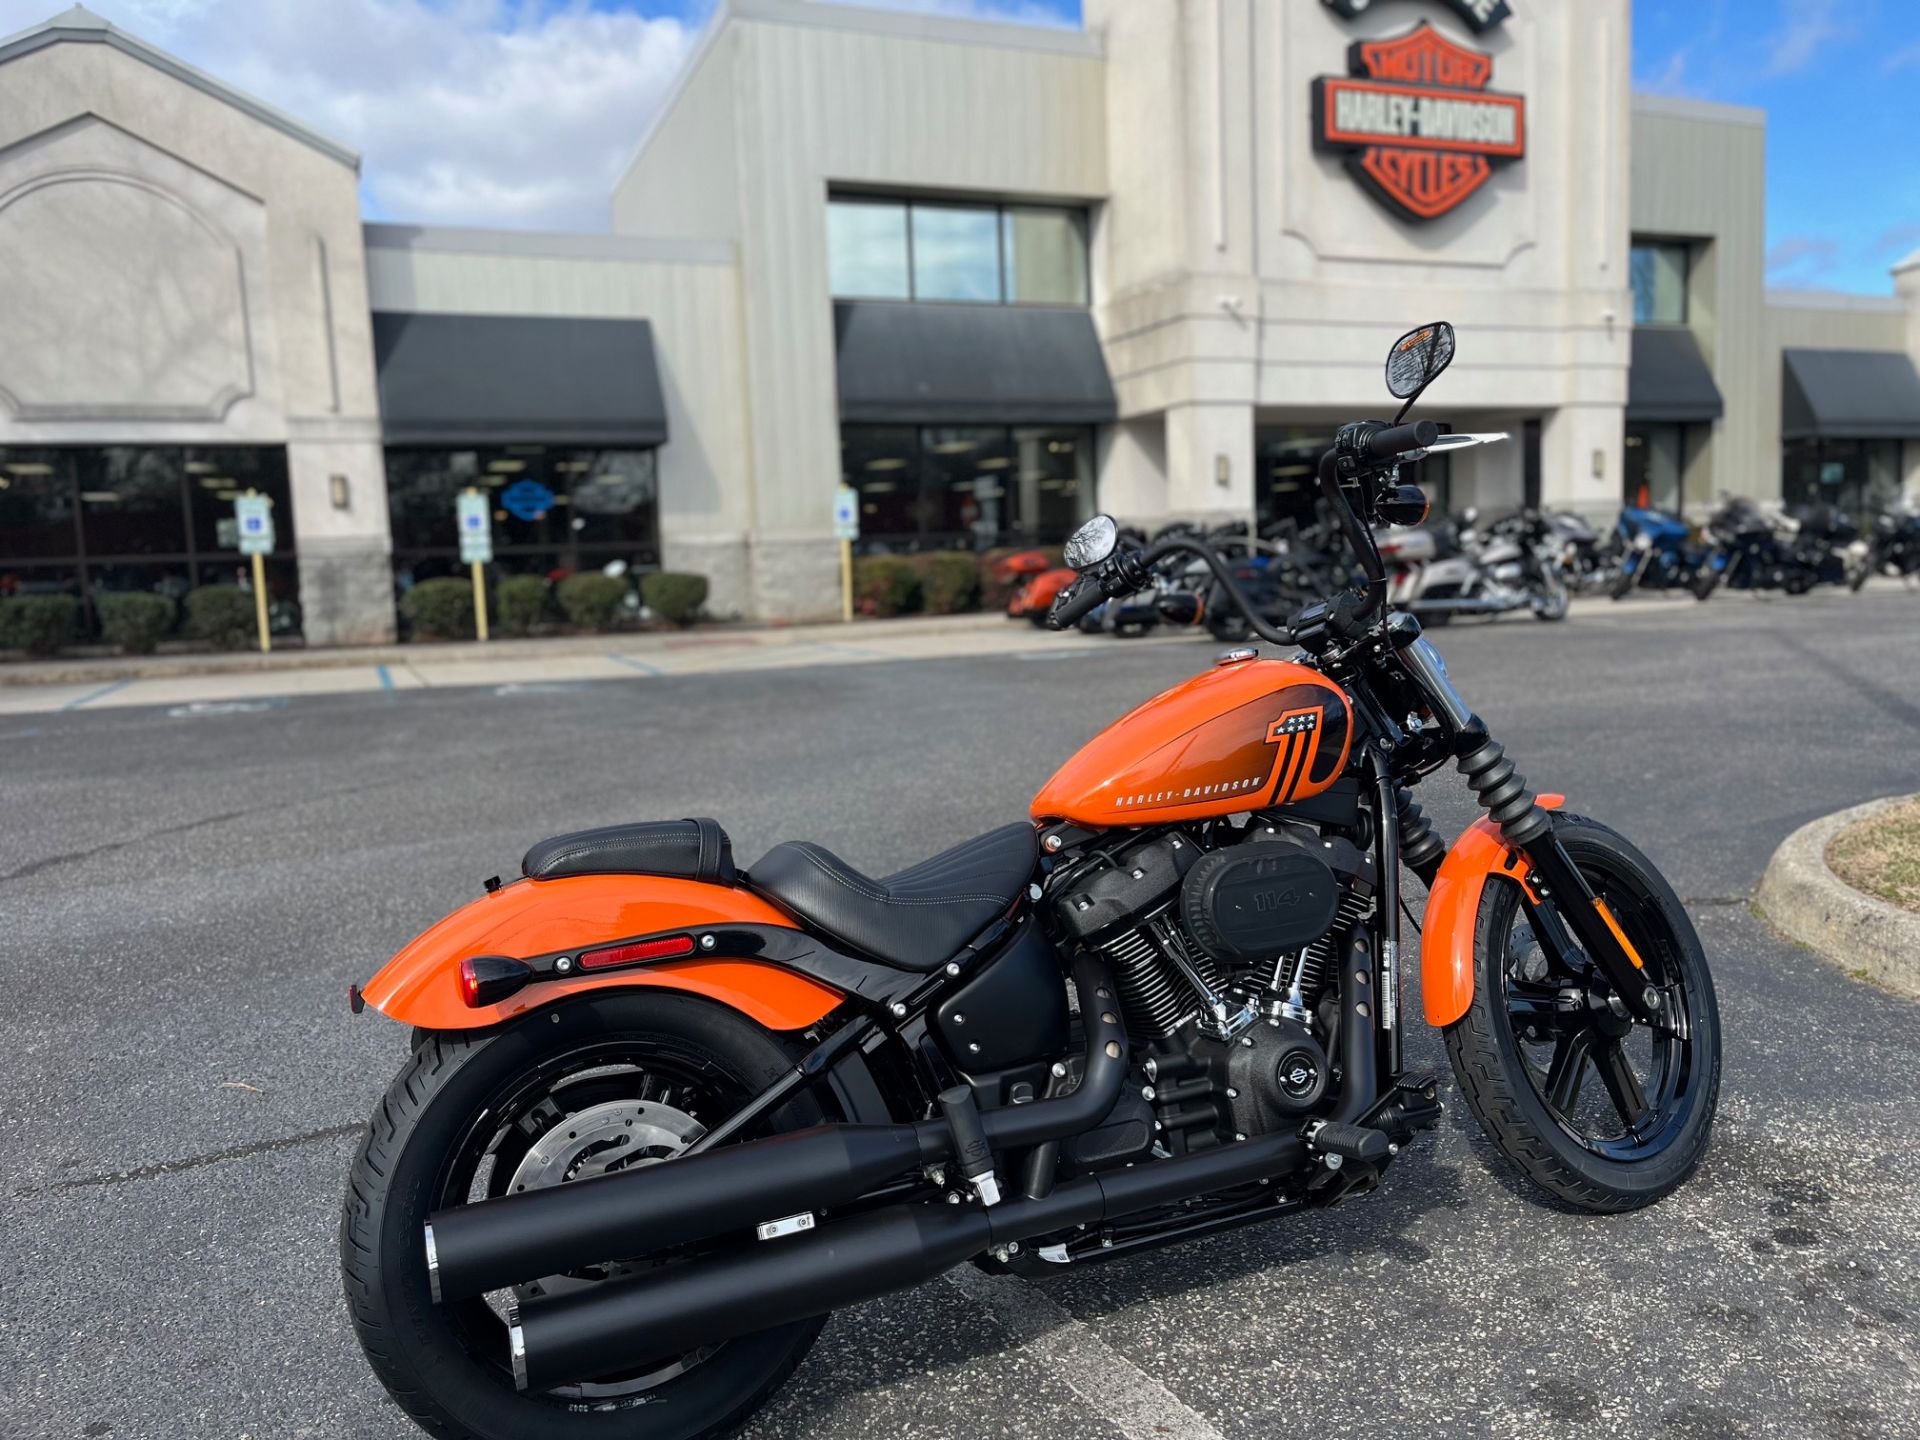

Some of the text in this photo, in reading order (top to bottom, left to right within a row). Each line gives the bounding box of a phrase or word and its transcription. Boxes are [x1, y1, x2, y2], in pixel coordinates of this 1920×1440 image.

[1336, 89, 1516, 145] HARLEY-DAVIDSON
[1116, 776, 1261, 806] HARLEY-DAVIDSON
[1253, 887, 1302, 912] 114
